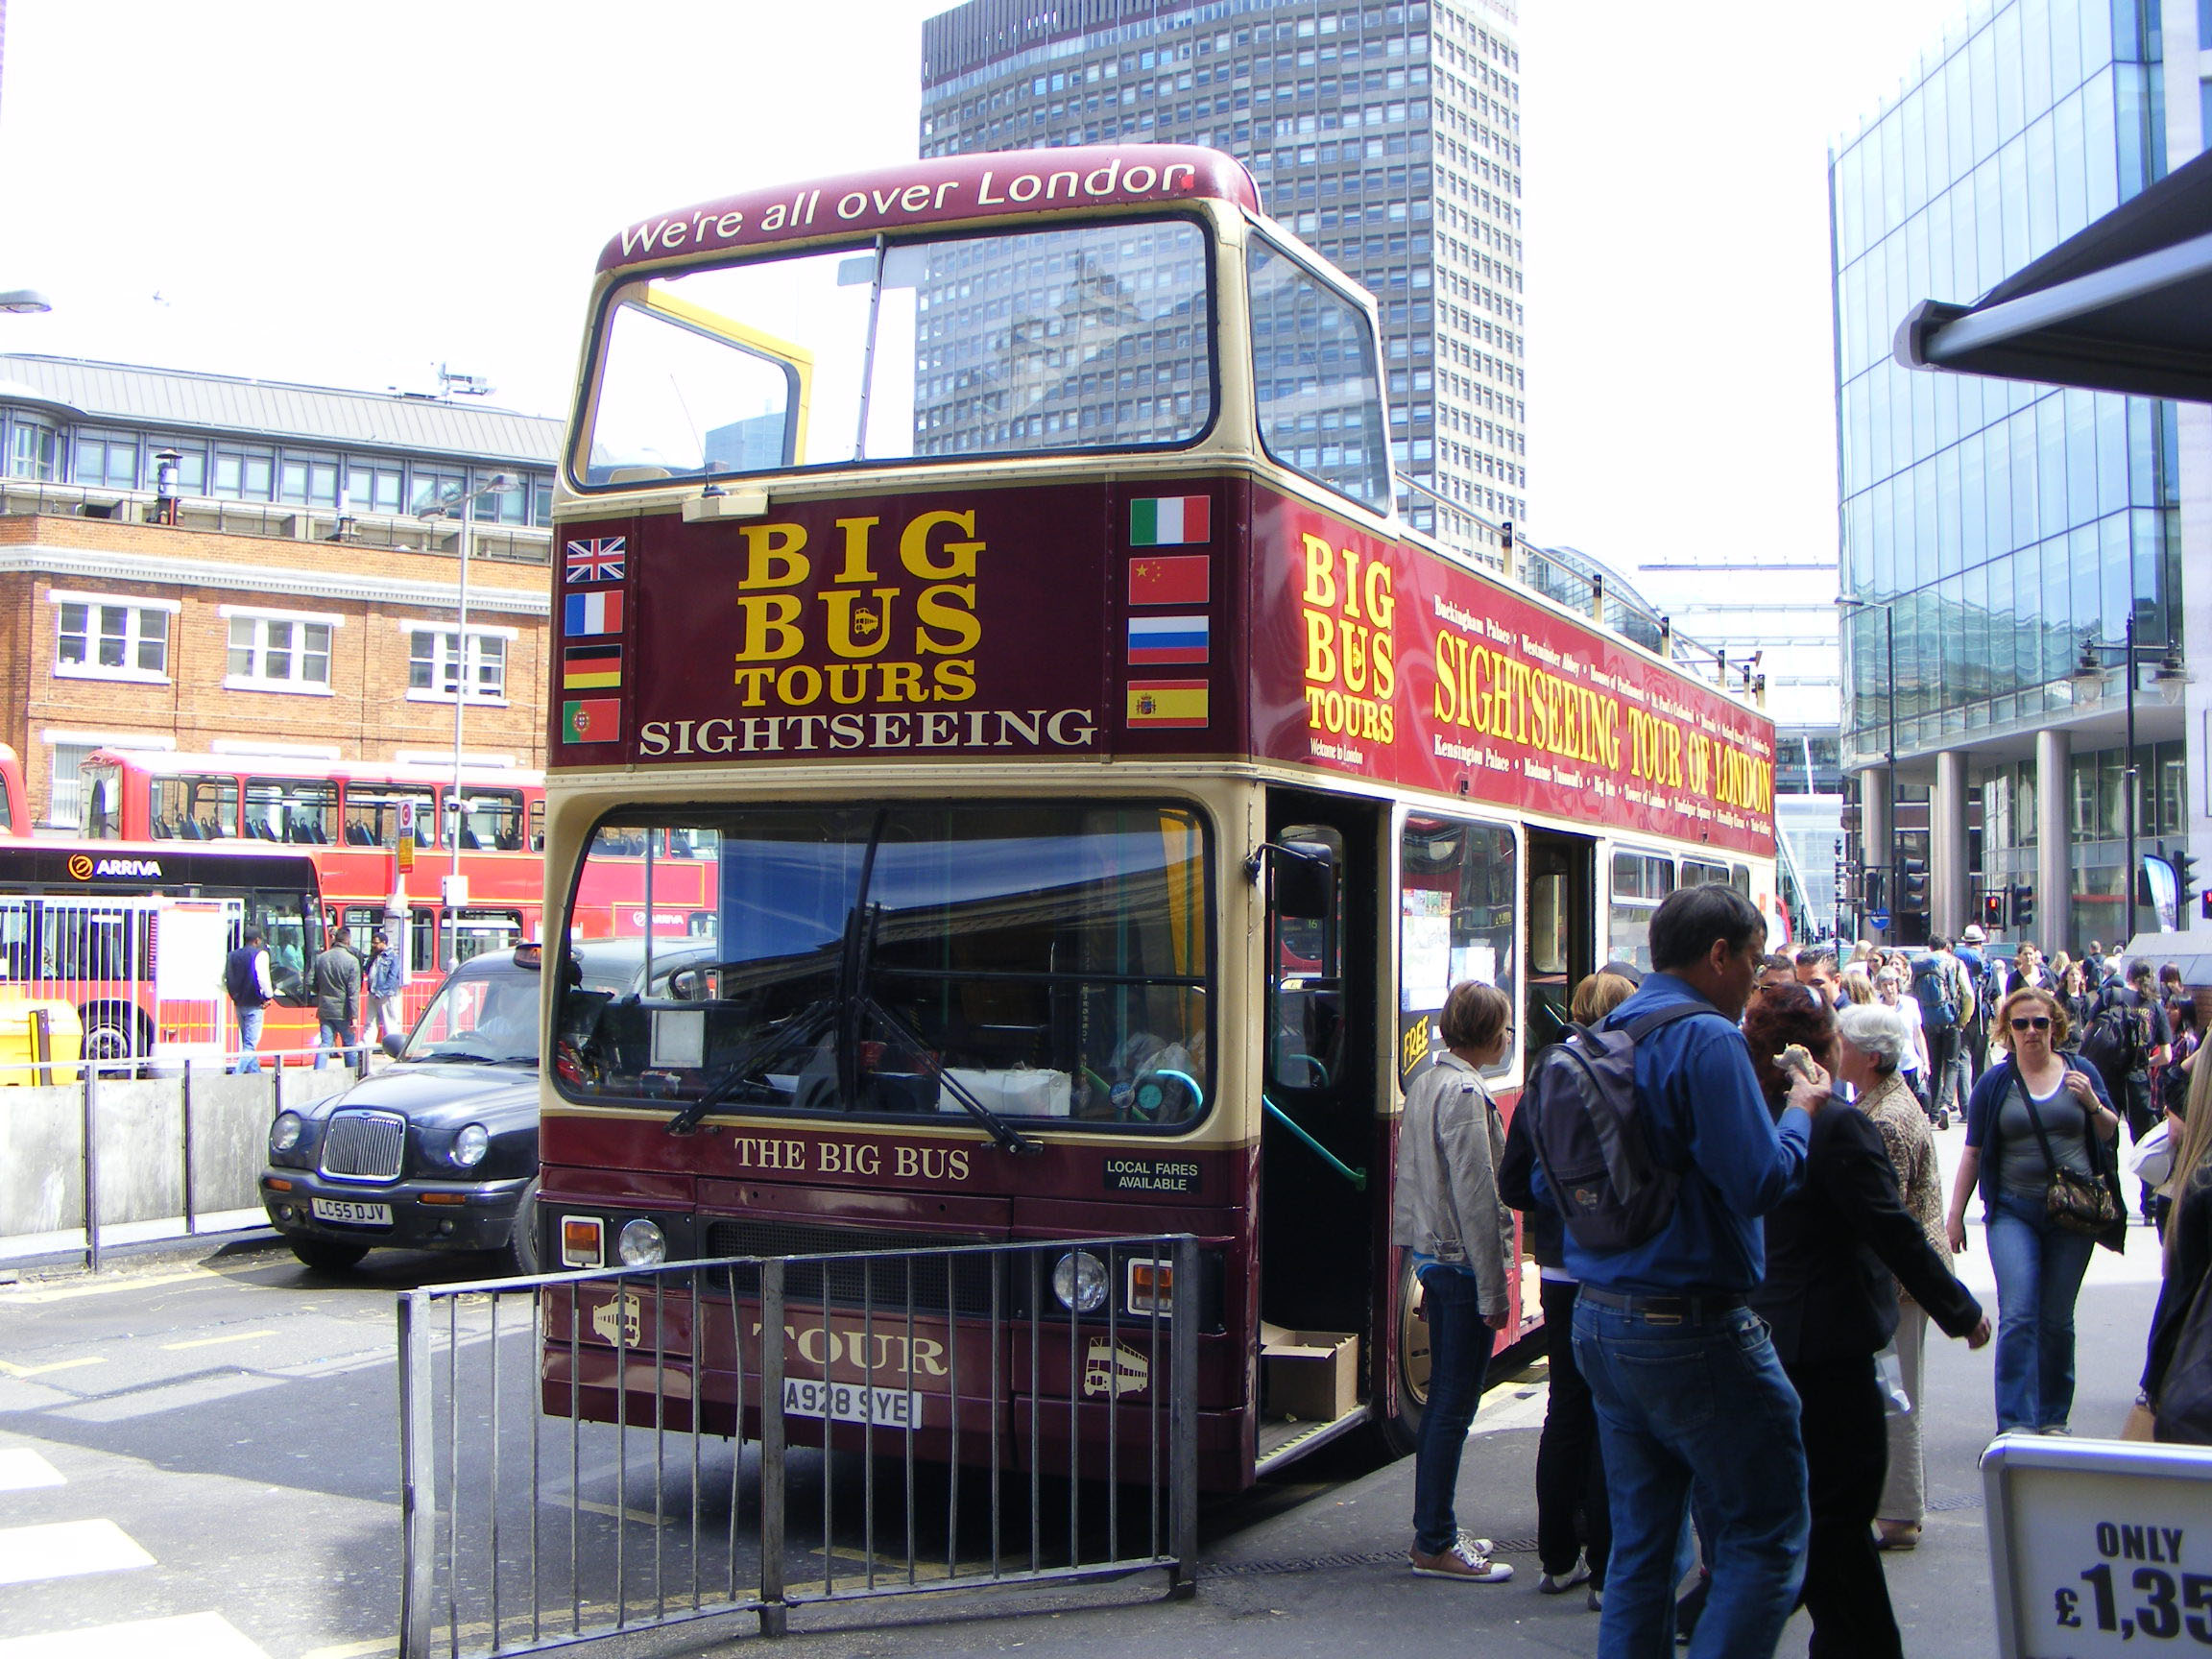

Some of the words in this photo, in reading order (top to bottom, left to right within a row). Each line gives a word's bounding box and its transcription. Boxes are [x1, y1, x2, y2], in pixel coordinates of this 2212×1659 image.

[621, 211, 744, 256] We're
[760, 189, 821, 231] all
[837, 181, 959, 220] over
[977, 158, 1195, 205] London
[739, 509, 987, 589] BIG
[1302, 532, 1395, 631] BIG
[735, 584, 982, 662] BUS
[1433, 593, 1484, 635] Buckingham
[1485, 617, 1511, 645] Palace
[1303, 607, 1395, 701] BUS
[733, 660, 977, 708] TOURS
[638, 709, 1098, 757] SIGHTSEEING
[1305, 685, 1395, 745] TOURS
[1433, 629, 1621, 772] SIGHTSEEING
[1627, 706, 1683, 789] TOUR
[1688, 731, 1711, 796] OF
[1714, 740, 1771, 815] LONDON
[1310, 737, 1336, 759] Welcome
[1336, 743, 1343, 760] to
[1344, 744, 1363, 765] London
[1433, 733, 1483, 766] Kensington
[1485, 747, 1510, 773] Palace
[96, 859, 162, 877] ARRIVA
[652, 914, 684, 925] RRIVA
[1403, 1015, 1430, 1068] FREE
[734, 1138, 805, 1170] THE
[817, 1142, 881, 1175] BIG
[894, 1146, 970, 1181] BUS
[1107, 1160, 1151, 1174] LOCAL
[1155, 1163, 1198, 1176] FARES
[1118, 1176, 1187, 1190] AVAILABLE
[318, 1200, 352, 1218] LC55
[355, 1204, 383, 1220] DJV
[785, 1382, 851, 1415] A928
[2096, 1521, 2183, 1564] ONLY
